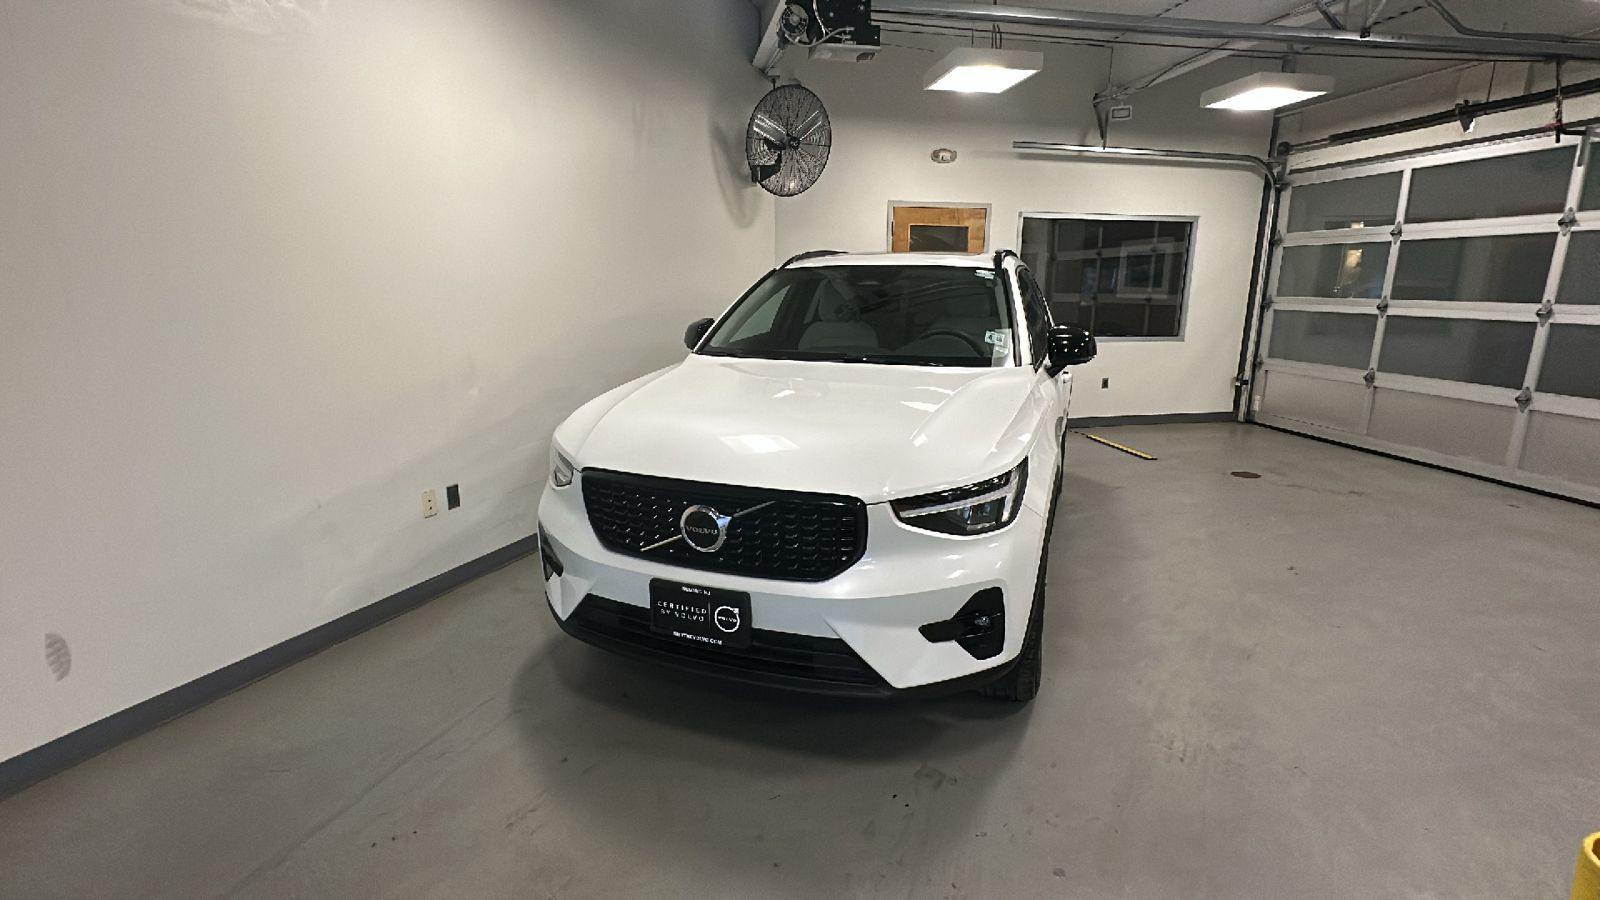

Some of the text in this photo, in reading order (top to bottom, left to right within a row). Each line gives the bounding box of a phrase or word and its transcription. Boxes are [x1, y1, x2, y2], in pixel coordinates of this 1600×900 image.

[685, 525, 718, 535] VOLVO
[657, 600, 707, 614] CERTIFIED
[674, 611, 705, 622] VOLVO
